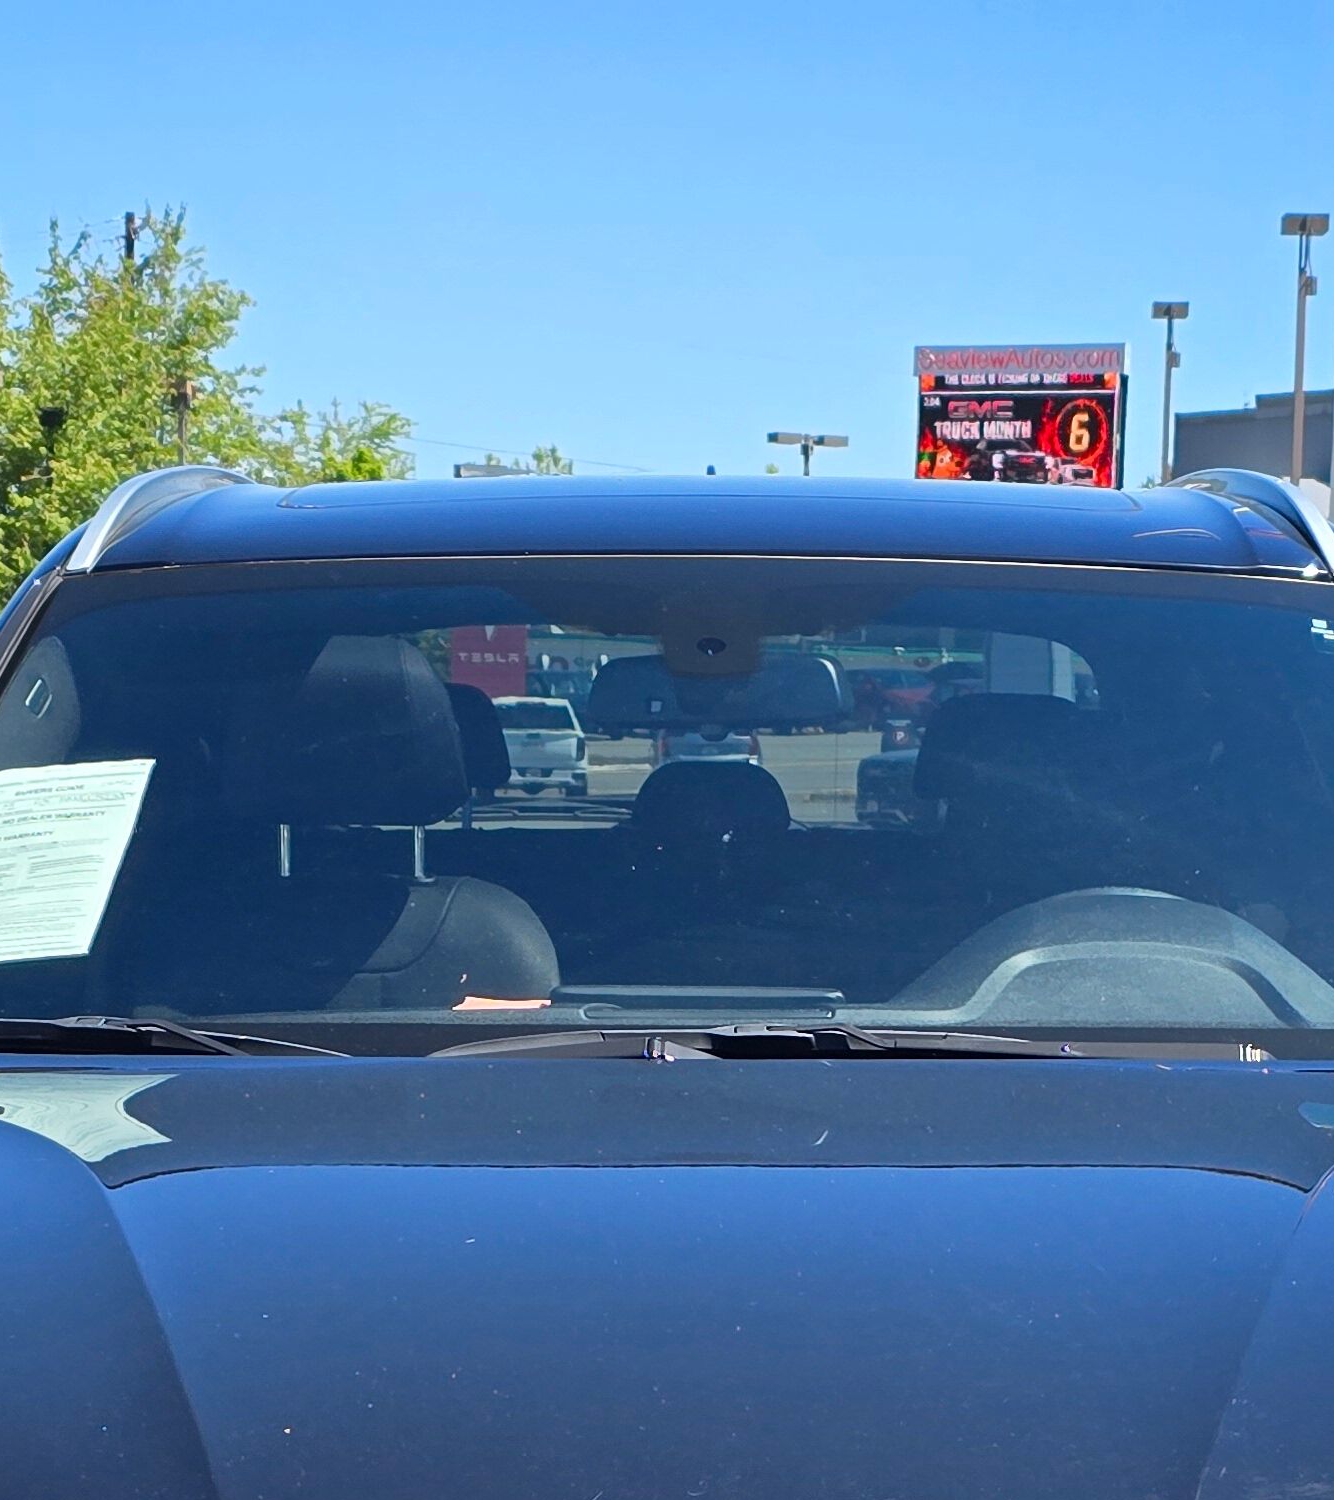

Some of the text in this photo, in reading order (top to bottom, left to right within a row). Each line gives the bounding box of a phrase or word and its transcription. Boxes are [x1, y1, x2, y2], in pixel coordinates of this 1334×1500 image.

[918, 347, 1120, 371] SeaviewAutos.com
[947, 400, 1014, 419] GMC
[934, 420, 1032, 440] TRUCK MONTH
[1069, 413, 1090, 452] 6
[458, 652, 520, 663] TESLA
